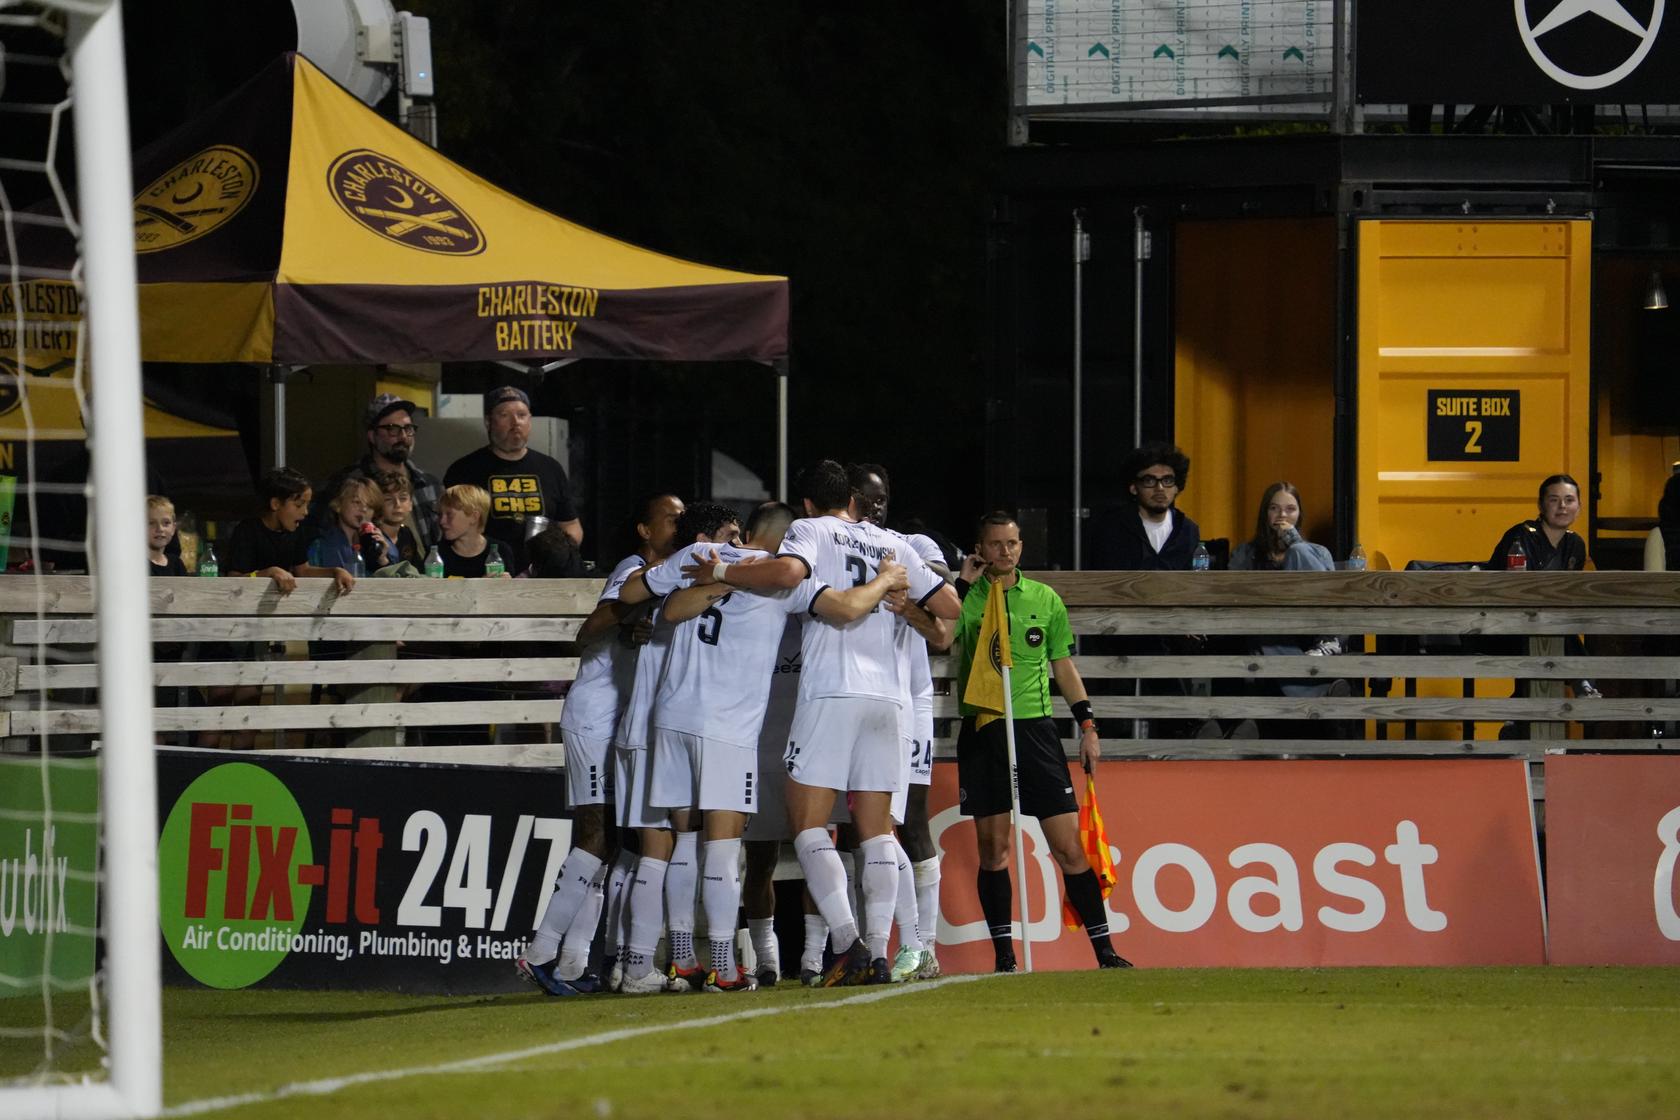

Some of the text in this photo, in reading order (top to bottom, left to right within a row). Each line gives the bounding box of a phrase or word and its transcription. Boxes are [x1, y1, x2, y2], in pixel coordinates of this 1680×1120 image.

[1045, 36, 1055, 94] DIGITALLY
[1111, 36, 1121, 95] DIGITALLY
[1176, 39, 1185, 96] DIGITALLY
[1240, 38, 1250, 96] DIGITALLY
[150, 158, 243, 200] CHARLESTON
[342, 161, 441, 202] CHARLESTON
[477, 284, 599, 317] CHARLESTON
[495, 320, 577, 351] BATTERY
[1436, 397, 1511, 416] SUITE BOX
[1464, 420, 1483, 453] 2
[491, 478, 538, 493] 843
[494, 496, 541, 512] CHS
[910, 739, 931, 768] 24
[184, 802, 573, 932] Fix-it 24/7
[182, 925, 533, 964] Air Conditioning, Plumbing & Heati
